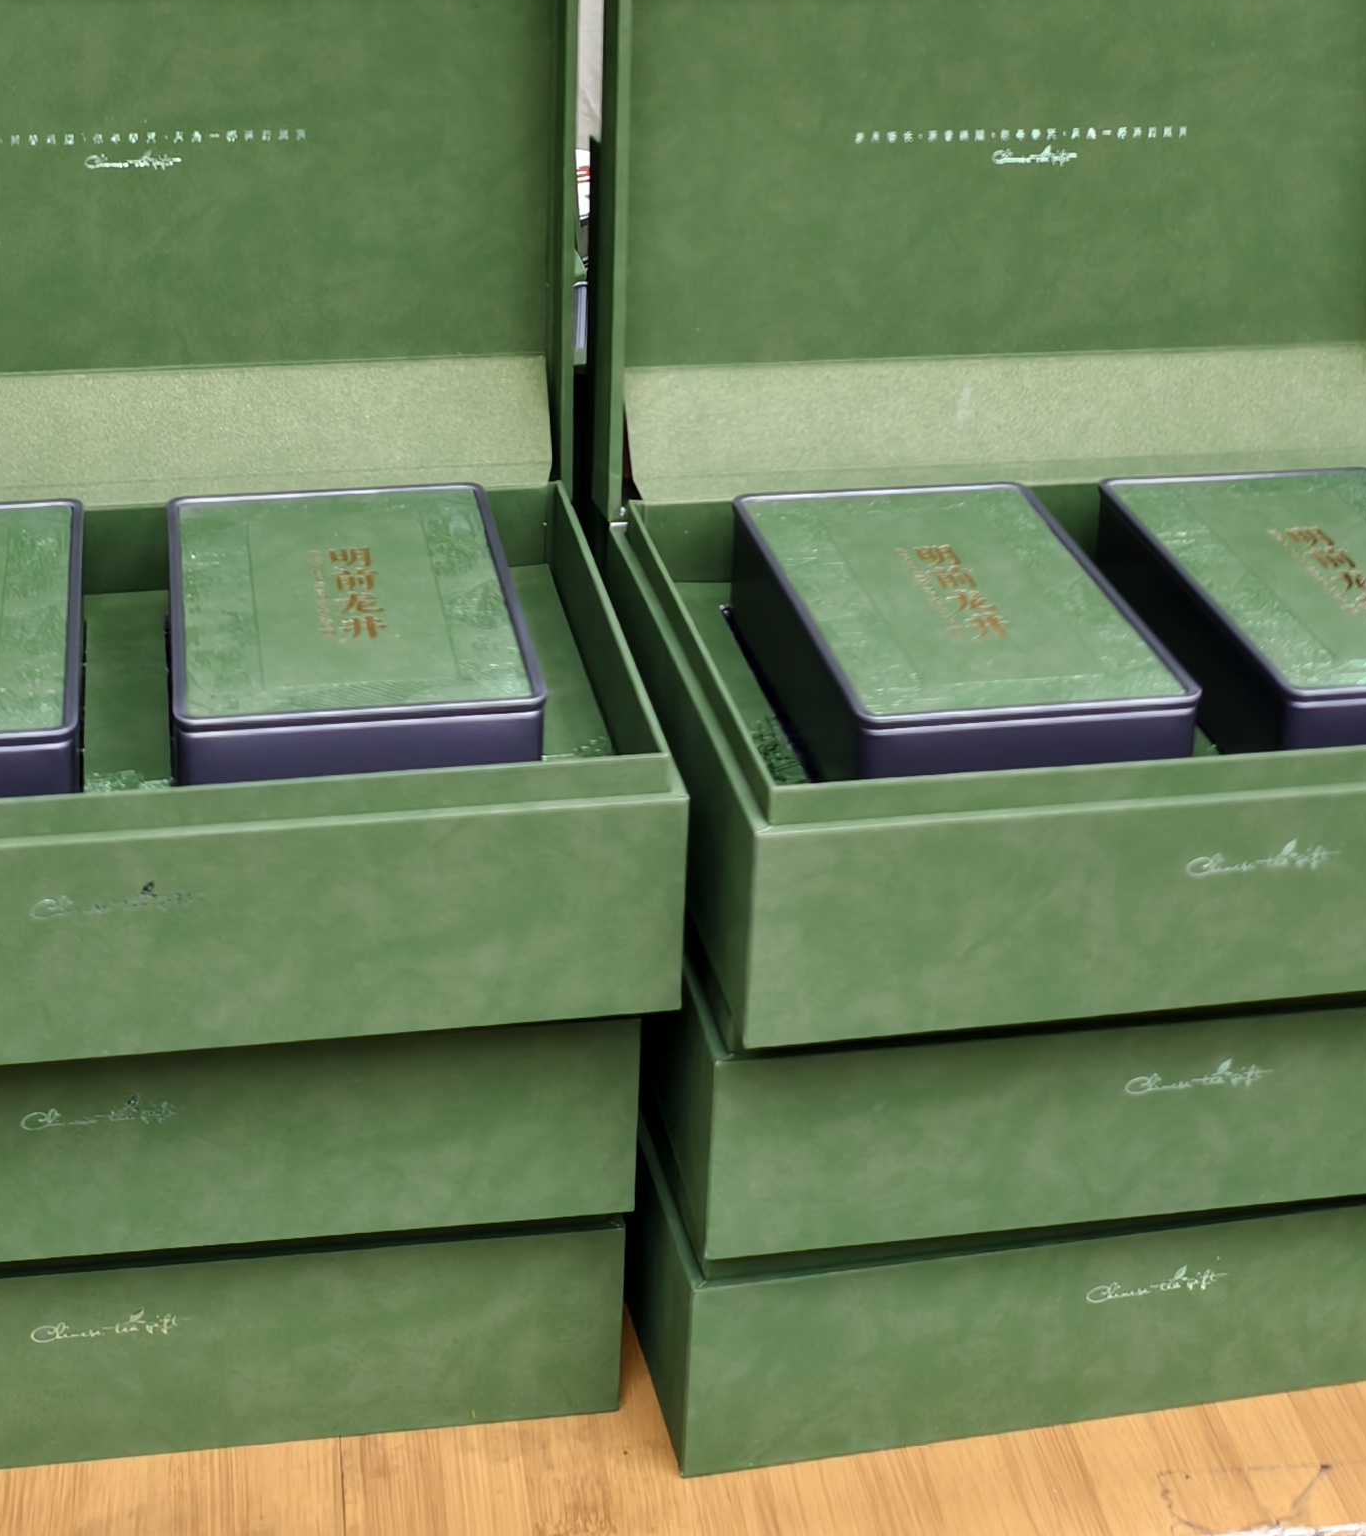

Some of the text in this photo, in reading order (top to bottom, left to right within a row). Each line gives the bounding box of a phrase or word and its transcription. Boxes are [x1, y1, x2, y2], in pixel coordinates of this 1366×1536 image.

[328, 547, 389, 641] 明前龙井
[912, 544, 1012, 641] 明前龙井
